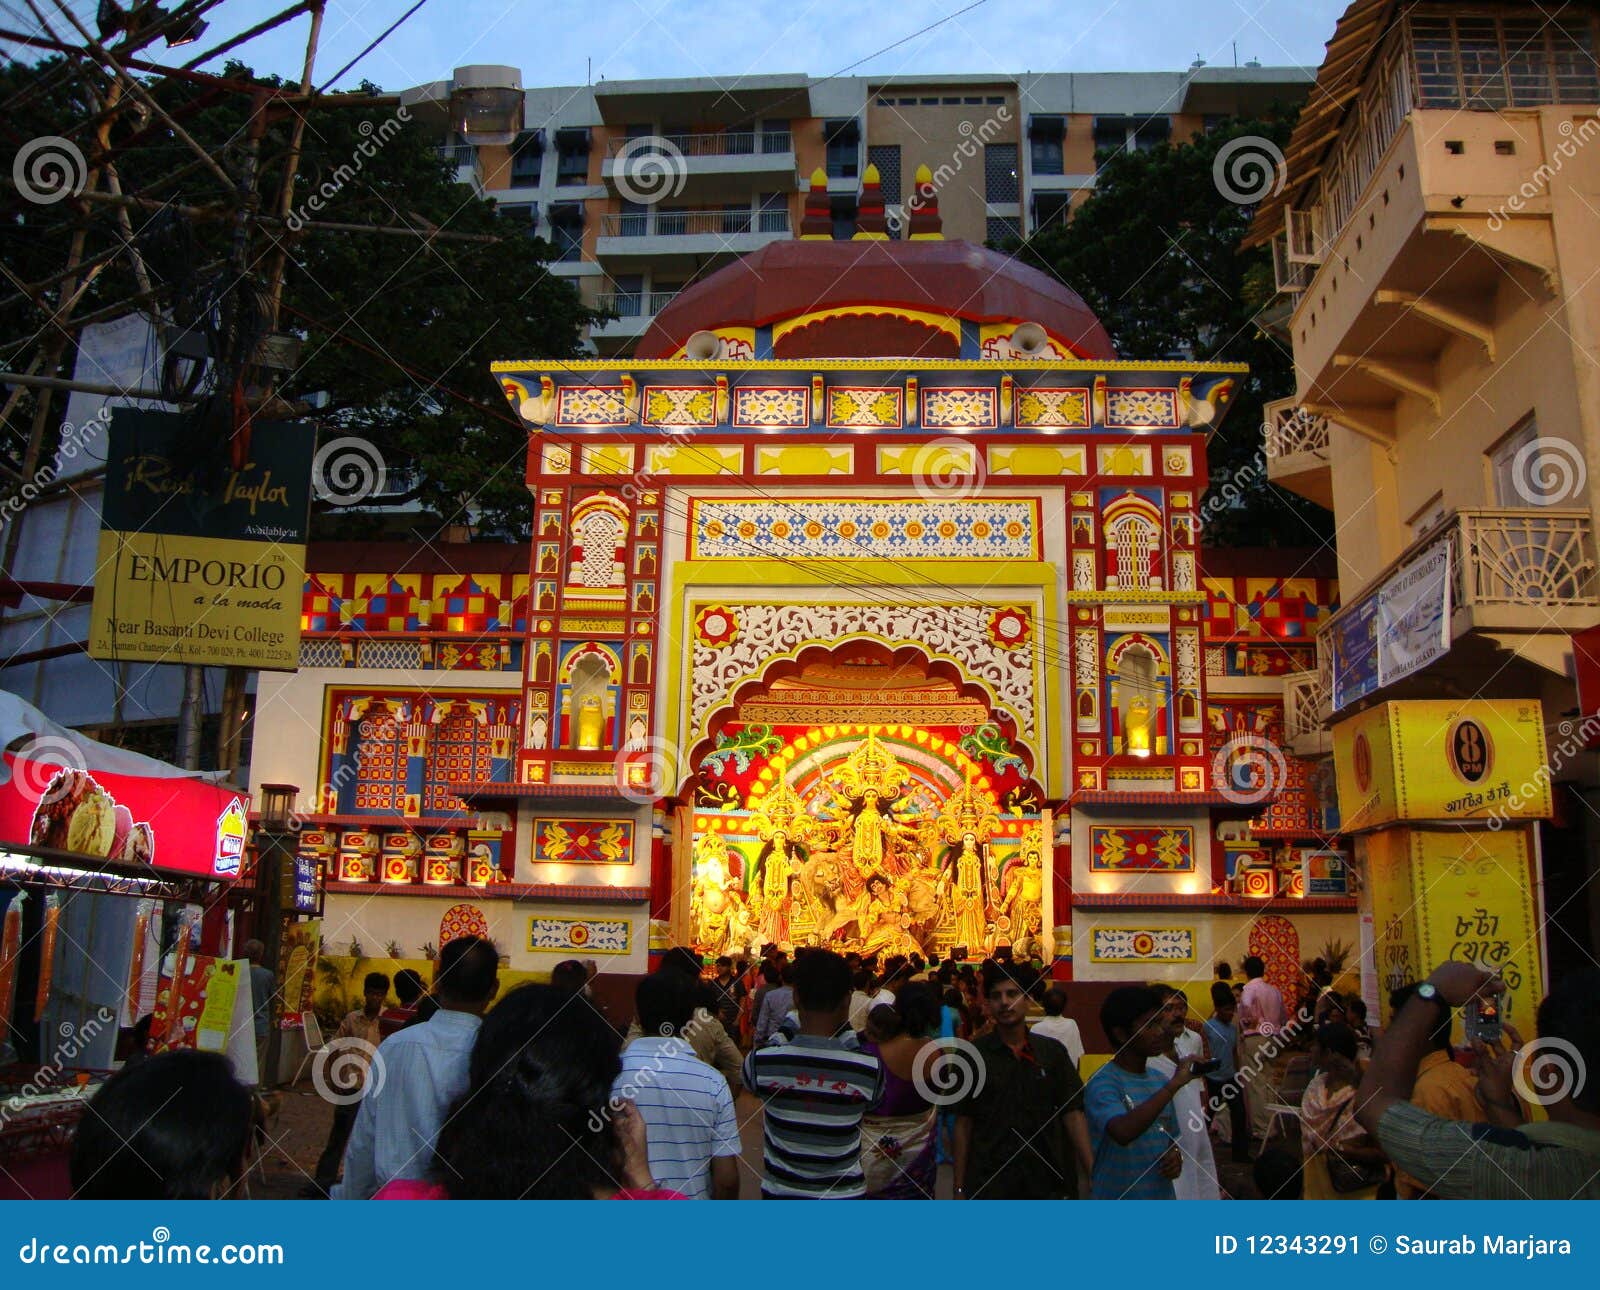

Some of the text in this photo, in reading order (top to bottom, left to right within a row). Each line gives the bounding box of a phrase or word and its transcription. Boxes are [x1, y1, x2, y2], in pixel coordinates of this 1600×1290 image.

[224, 462, 289, 516] Taylor
[245, 525, 298, 538] Available at
[128, 555, 285, 590] EMPORIO
[194, 593, 283, 610] a la moda
[106, 618, 284, 646] Near Basanti Devi College
[1460, 725, 1481, 762] 8
[1462, 763, 1482, 773] PM
